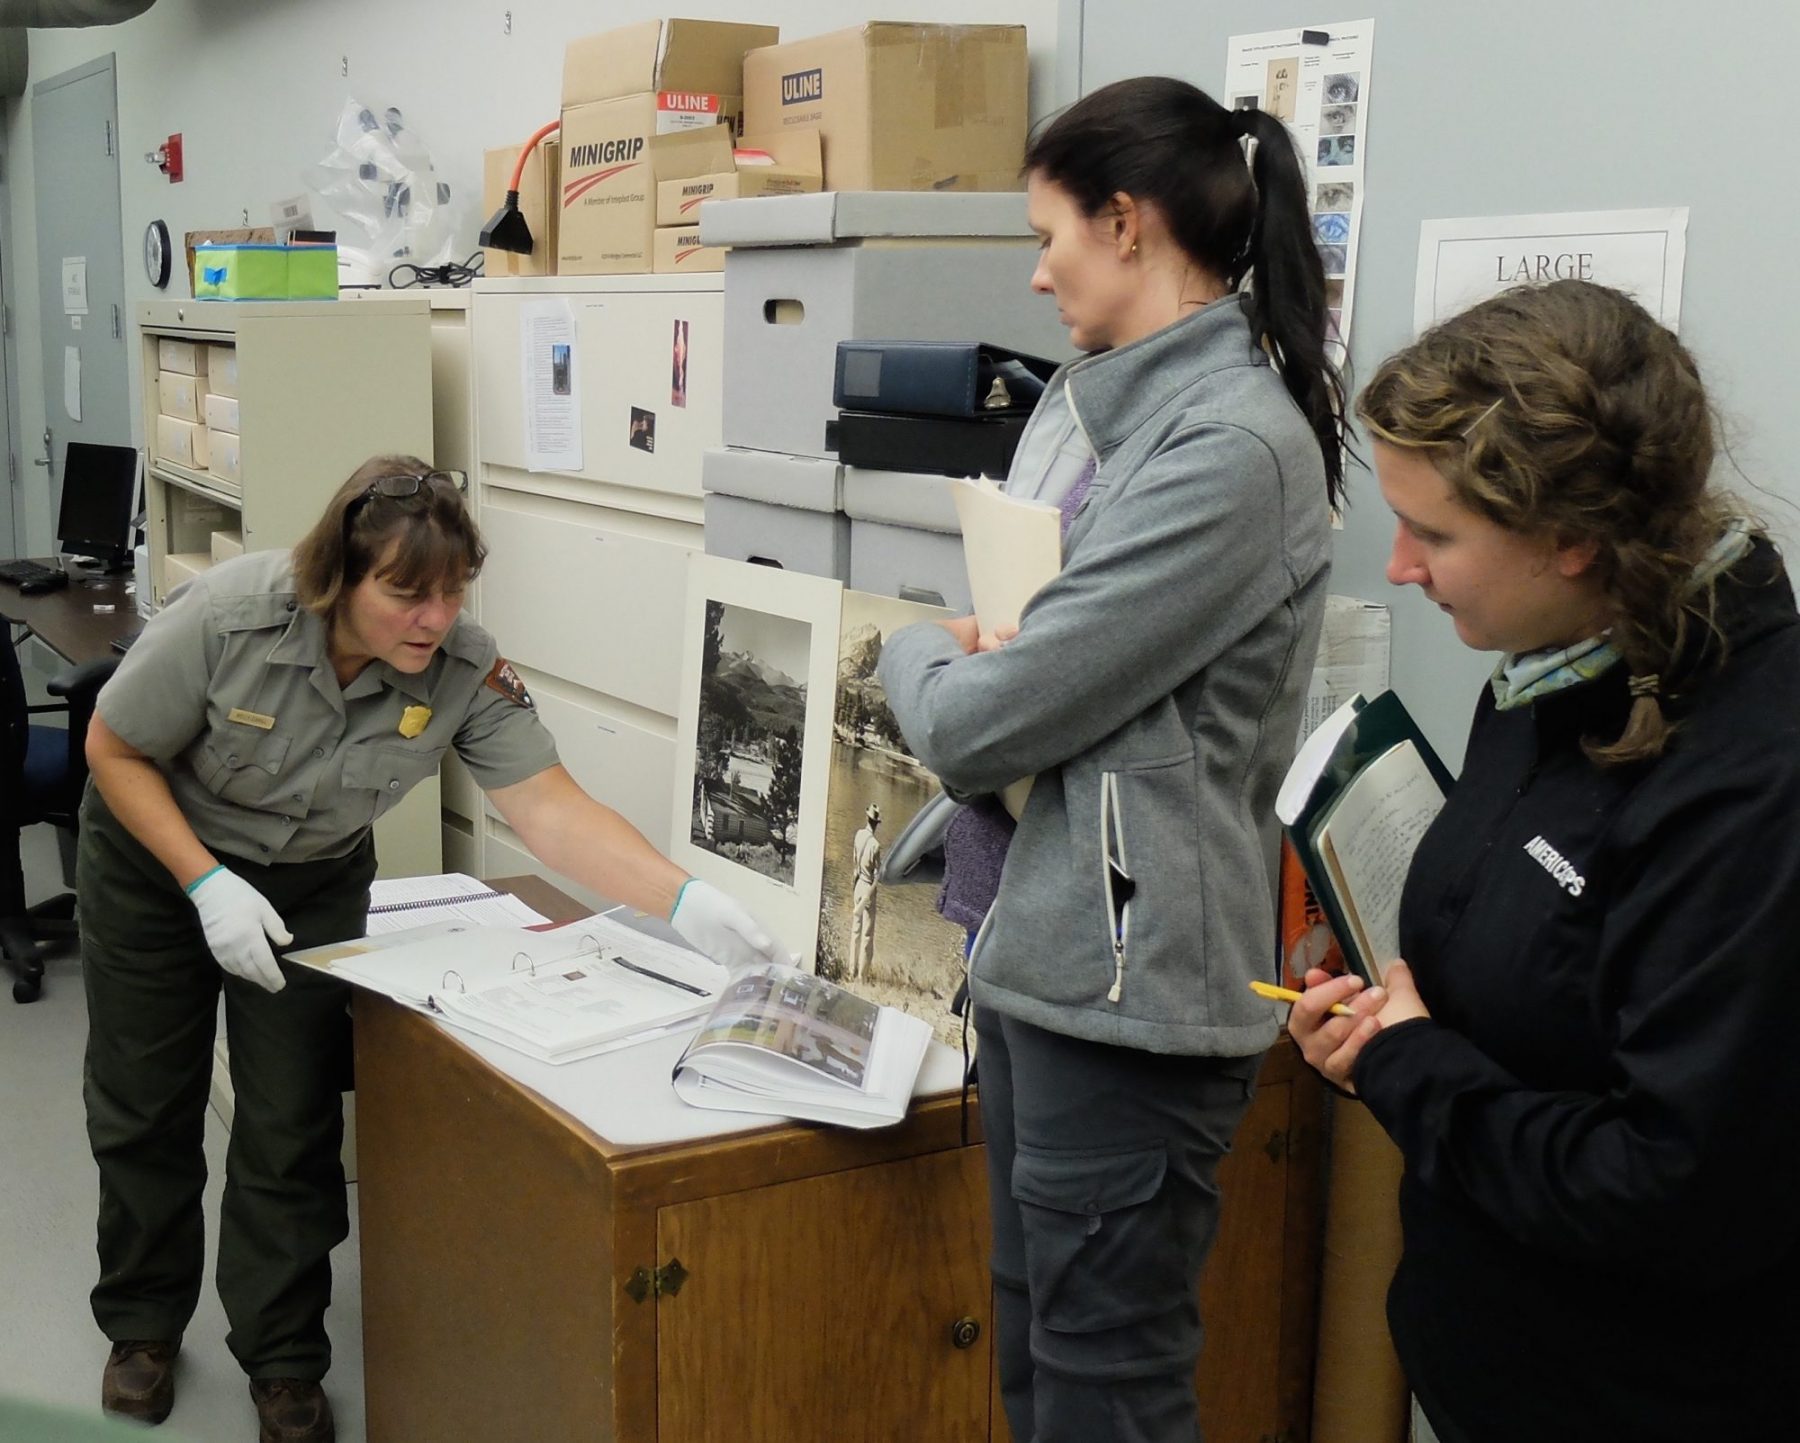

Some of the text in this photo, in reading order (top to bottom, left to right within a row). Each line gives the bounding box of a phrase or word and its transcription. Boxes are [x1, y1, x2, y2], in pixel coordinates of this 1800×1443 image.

[784, 73, 820, 100] ULINE
[666, 94, 709, 111] ULINE
[569, 137, 644, 168] MINIGRIP
[682, 183, 714, 196] MINIGRIP
[1496, 253, 1593, 282] LARGE
